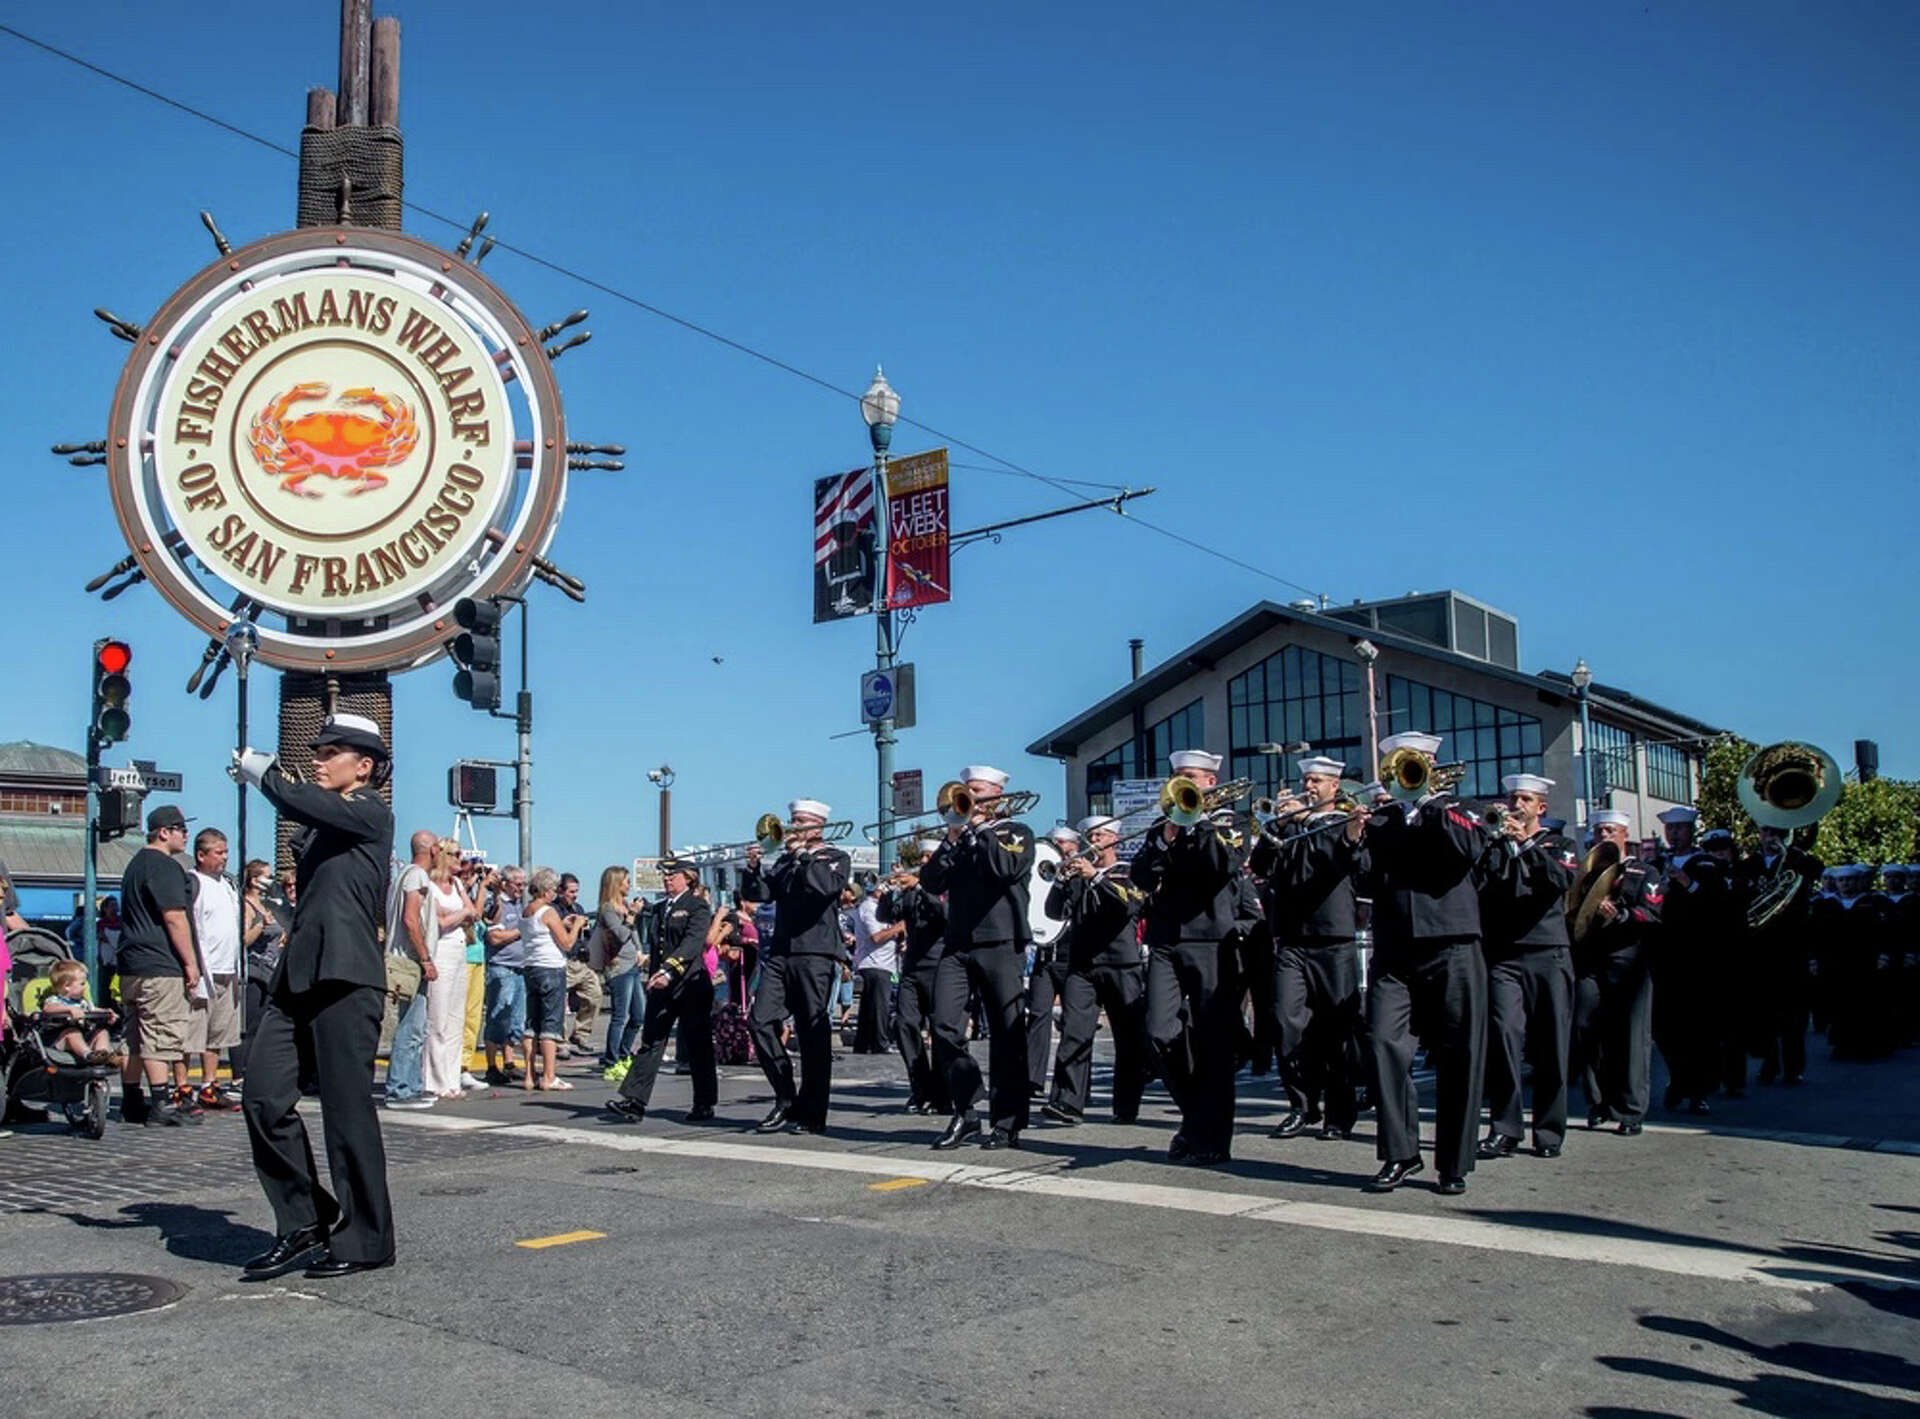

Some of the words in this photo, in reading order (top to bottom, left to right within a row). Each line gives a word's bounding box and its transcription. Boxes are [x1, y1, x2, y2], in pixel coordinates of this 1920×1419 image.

[174, 288, 398, 447] FISHERMANS
[393, 307, 491, 448] WHARF
[891, 489, 947, 520] FLEET
[177, 462, 225, 513] OF
[207, 513, 286, 584] SAN
[287, 462, 485, 597] FRANCISCO
[892, 510, 947, 539] WEEK
[892, 531, 947, 556] OCTOBER
[109, 772, 176, 788] Jefferson
